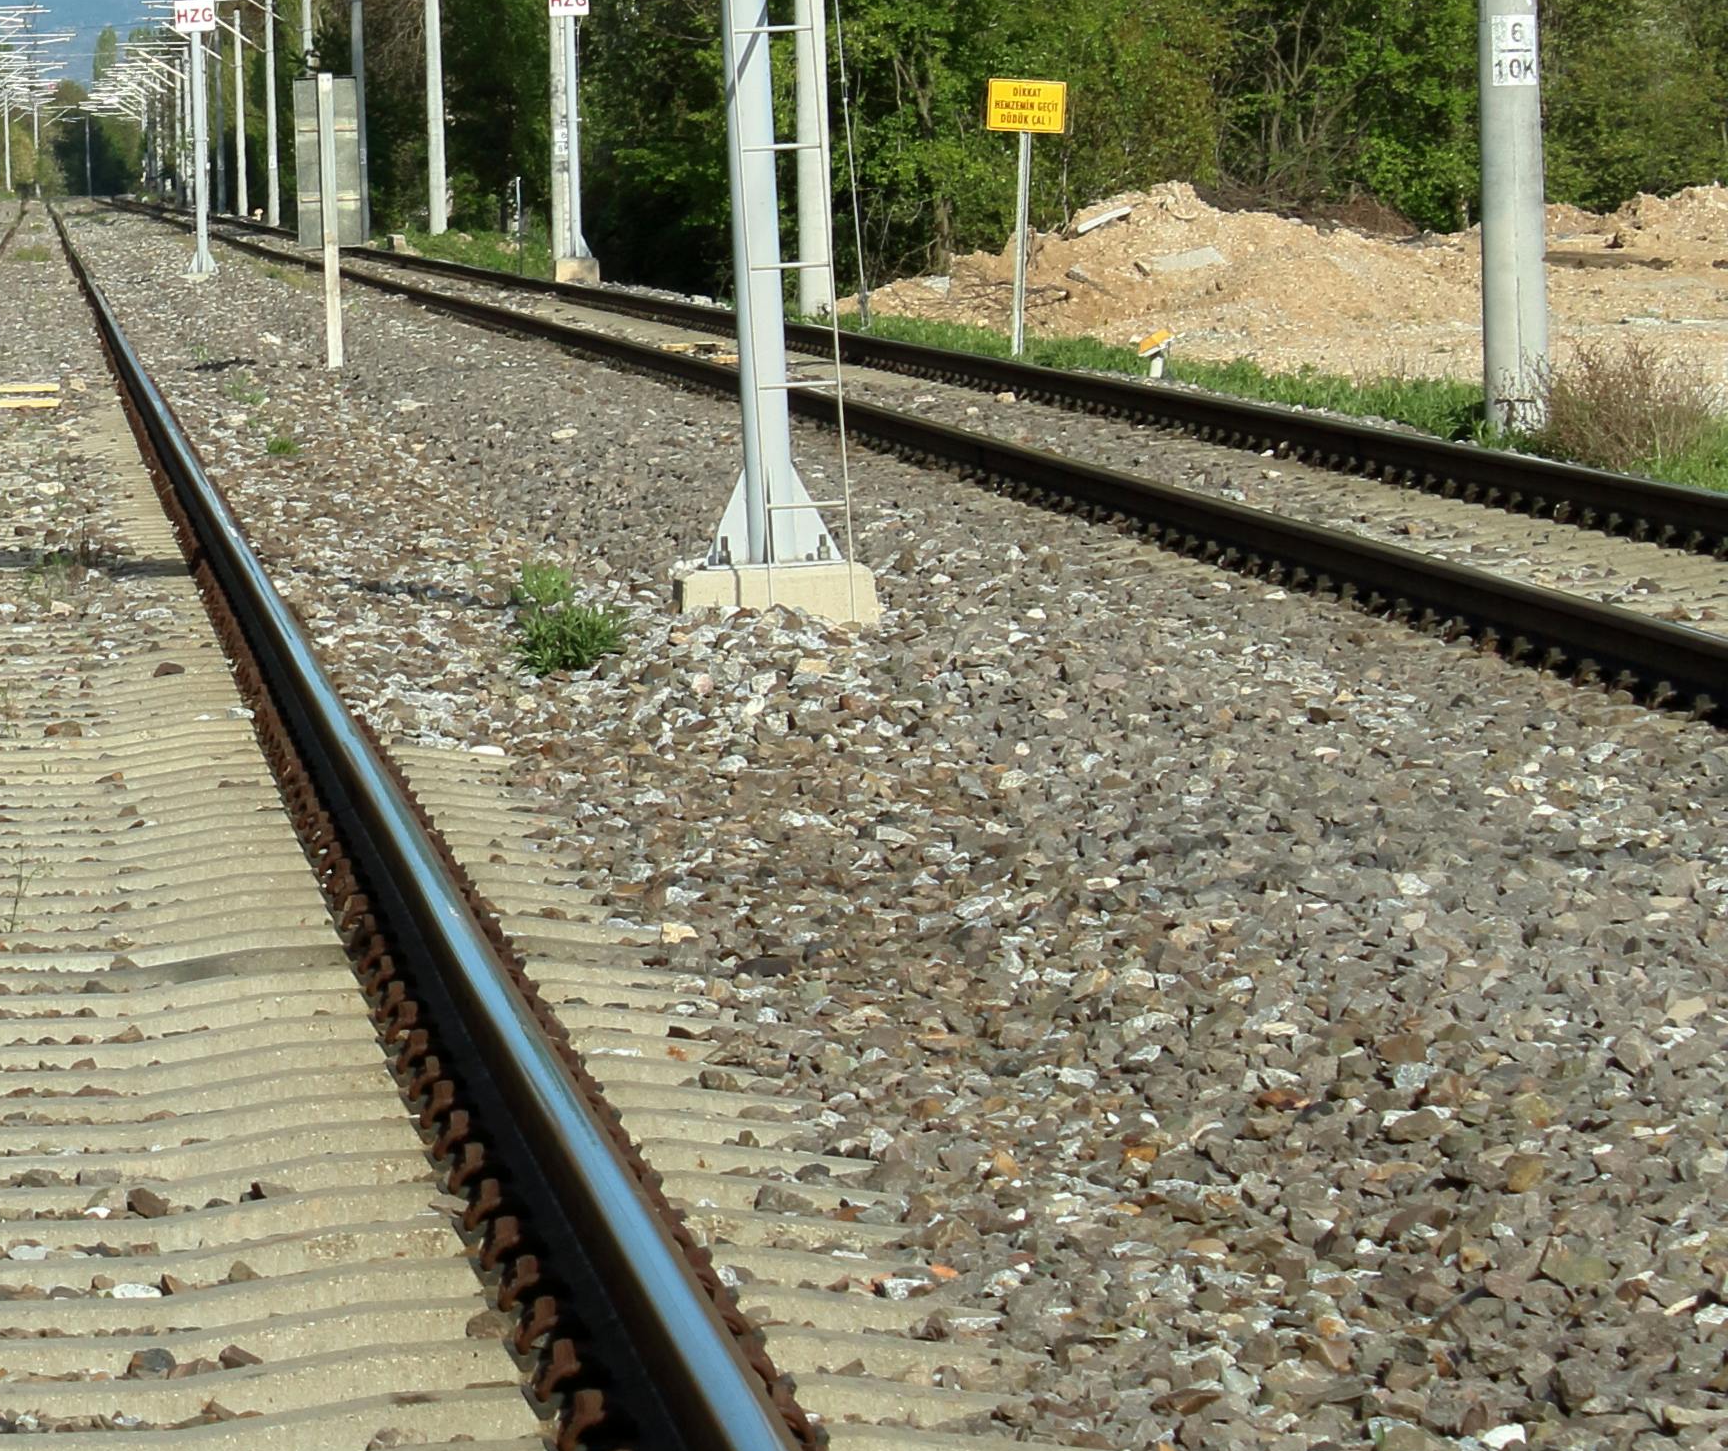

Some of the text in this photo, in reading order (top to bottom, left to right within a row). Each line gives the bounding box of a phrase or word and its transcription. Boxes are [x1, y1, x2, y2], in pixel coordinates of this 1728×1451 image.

[176, 7, 213, 24] HZG
[1511, 22, 1523, 43] 6
[1494, 58, 1537, 80] 10K
[1012, 84, 1042, 98] DİKKAT
[1000, 111, 1029, 124] DÜDÜK
